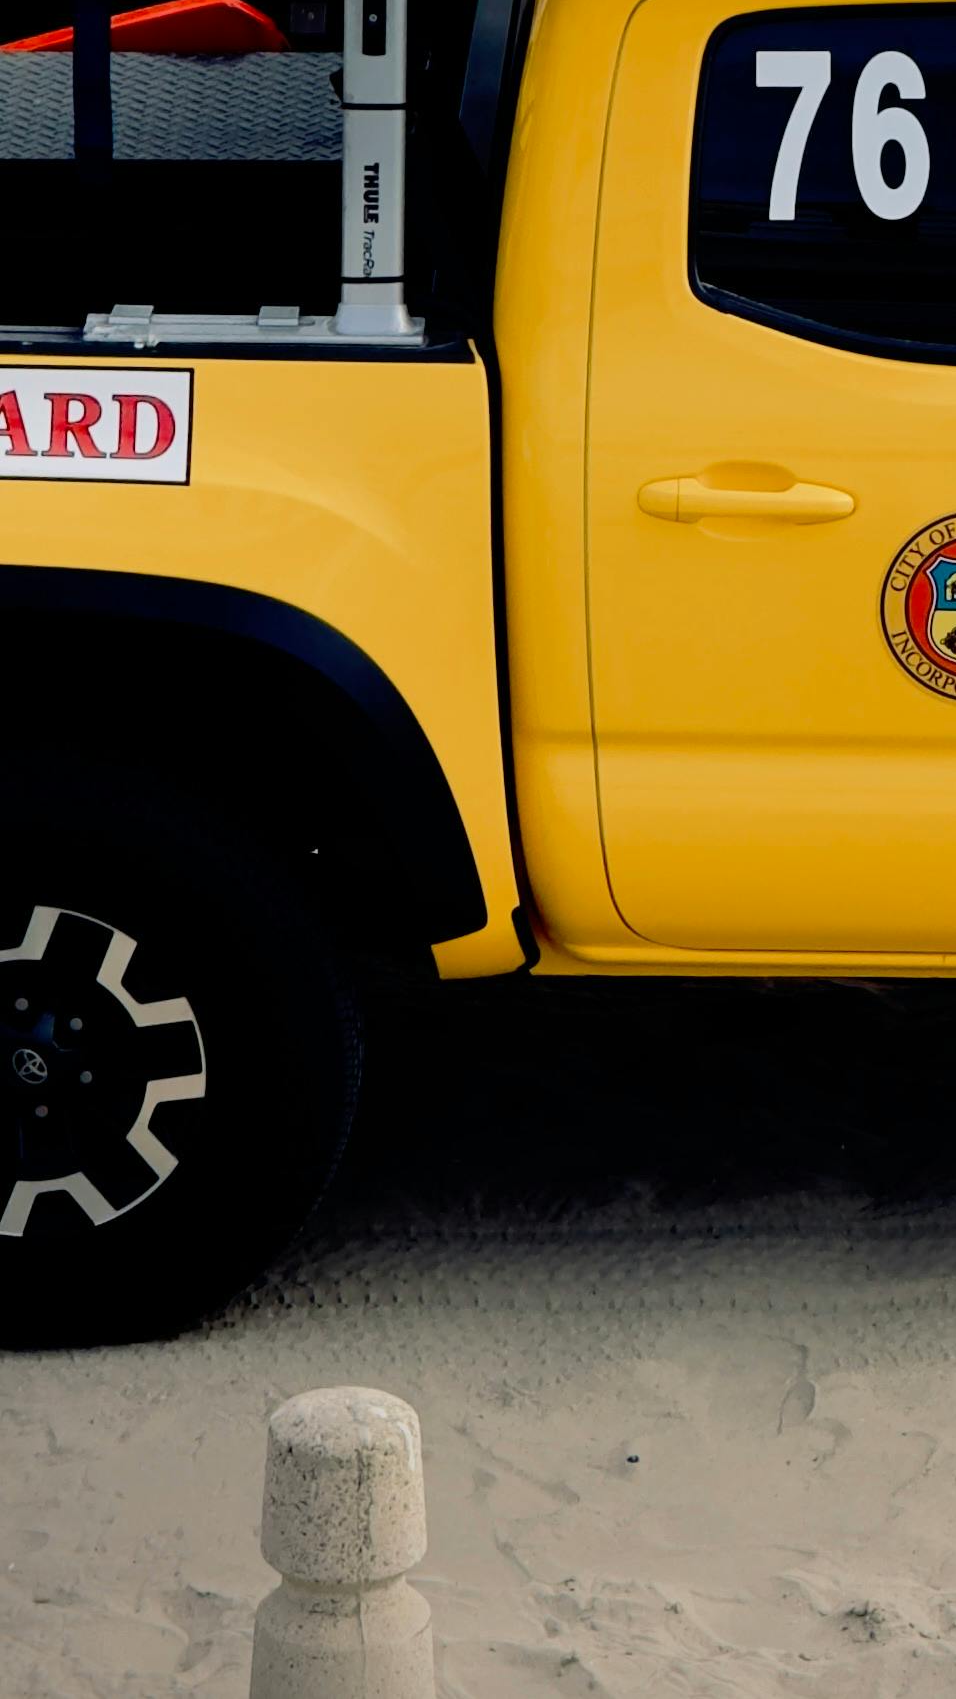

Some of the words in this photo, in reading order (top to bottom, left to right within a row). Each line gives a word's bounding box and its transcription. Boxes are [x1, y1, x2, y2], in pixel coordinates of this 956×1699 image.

[756, 50, 930, 221] 76
[363, 163, 379, 224] THULE
[363, 230, 375, 278] TracRa
[891, 542, 925, 592] CITY
[928, 522, 956, 546] OF
